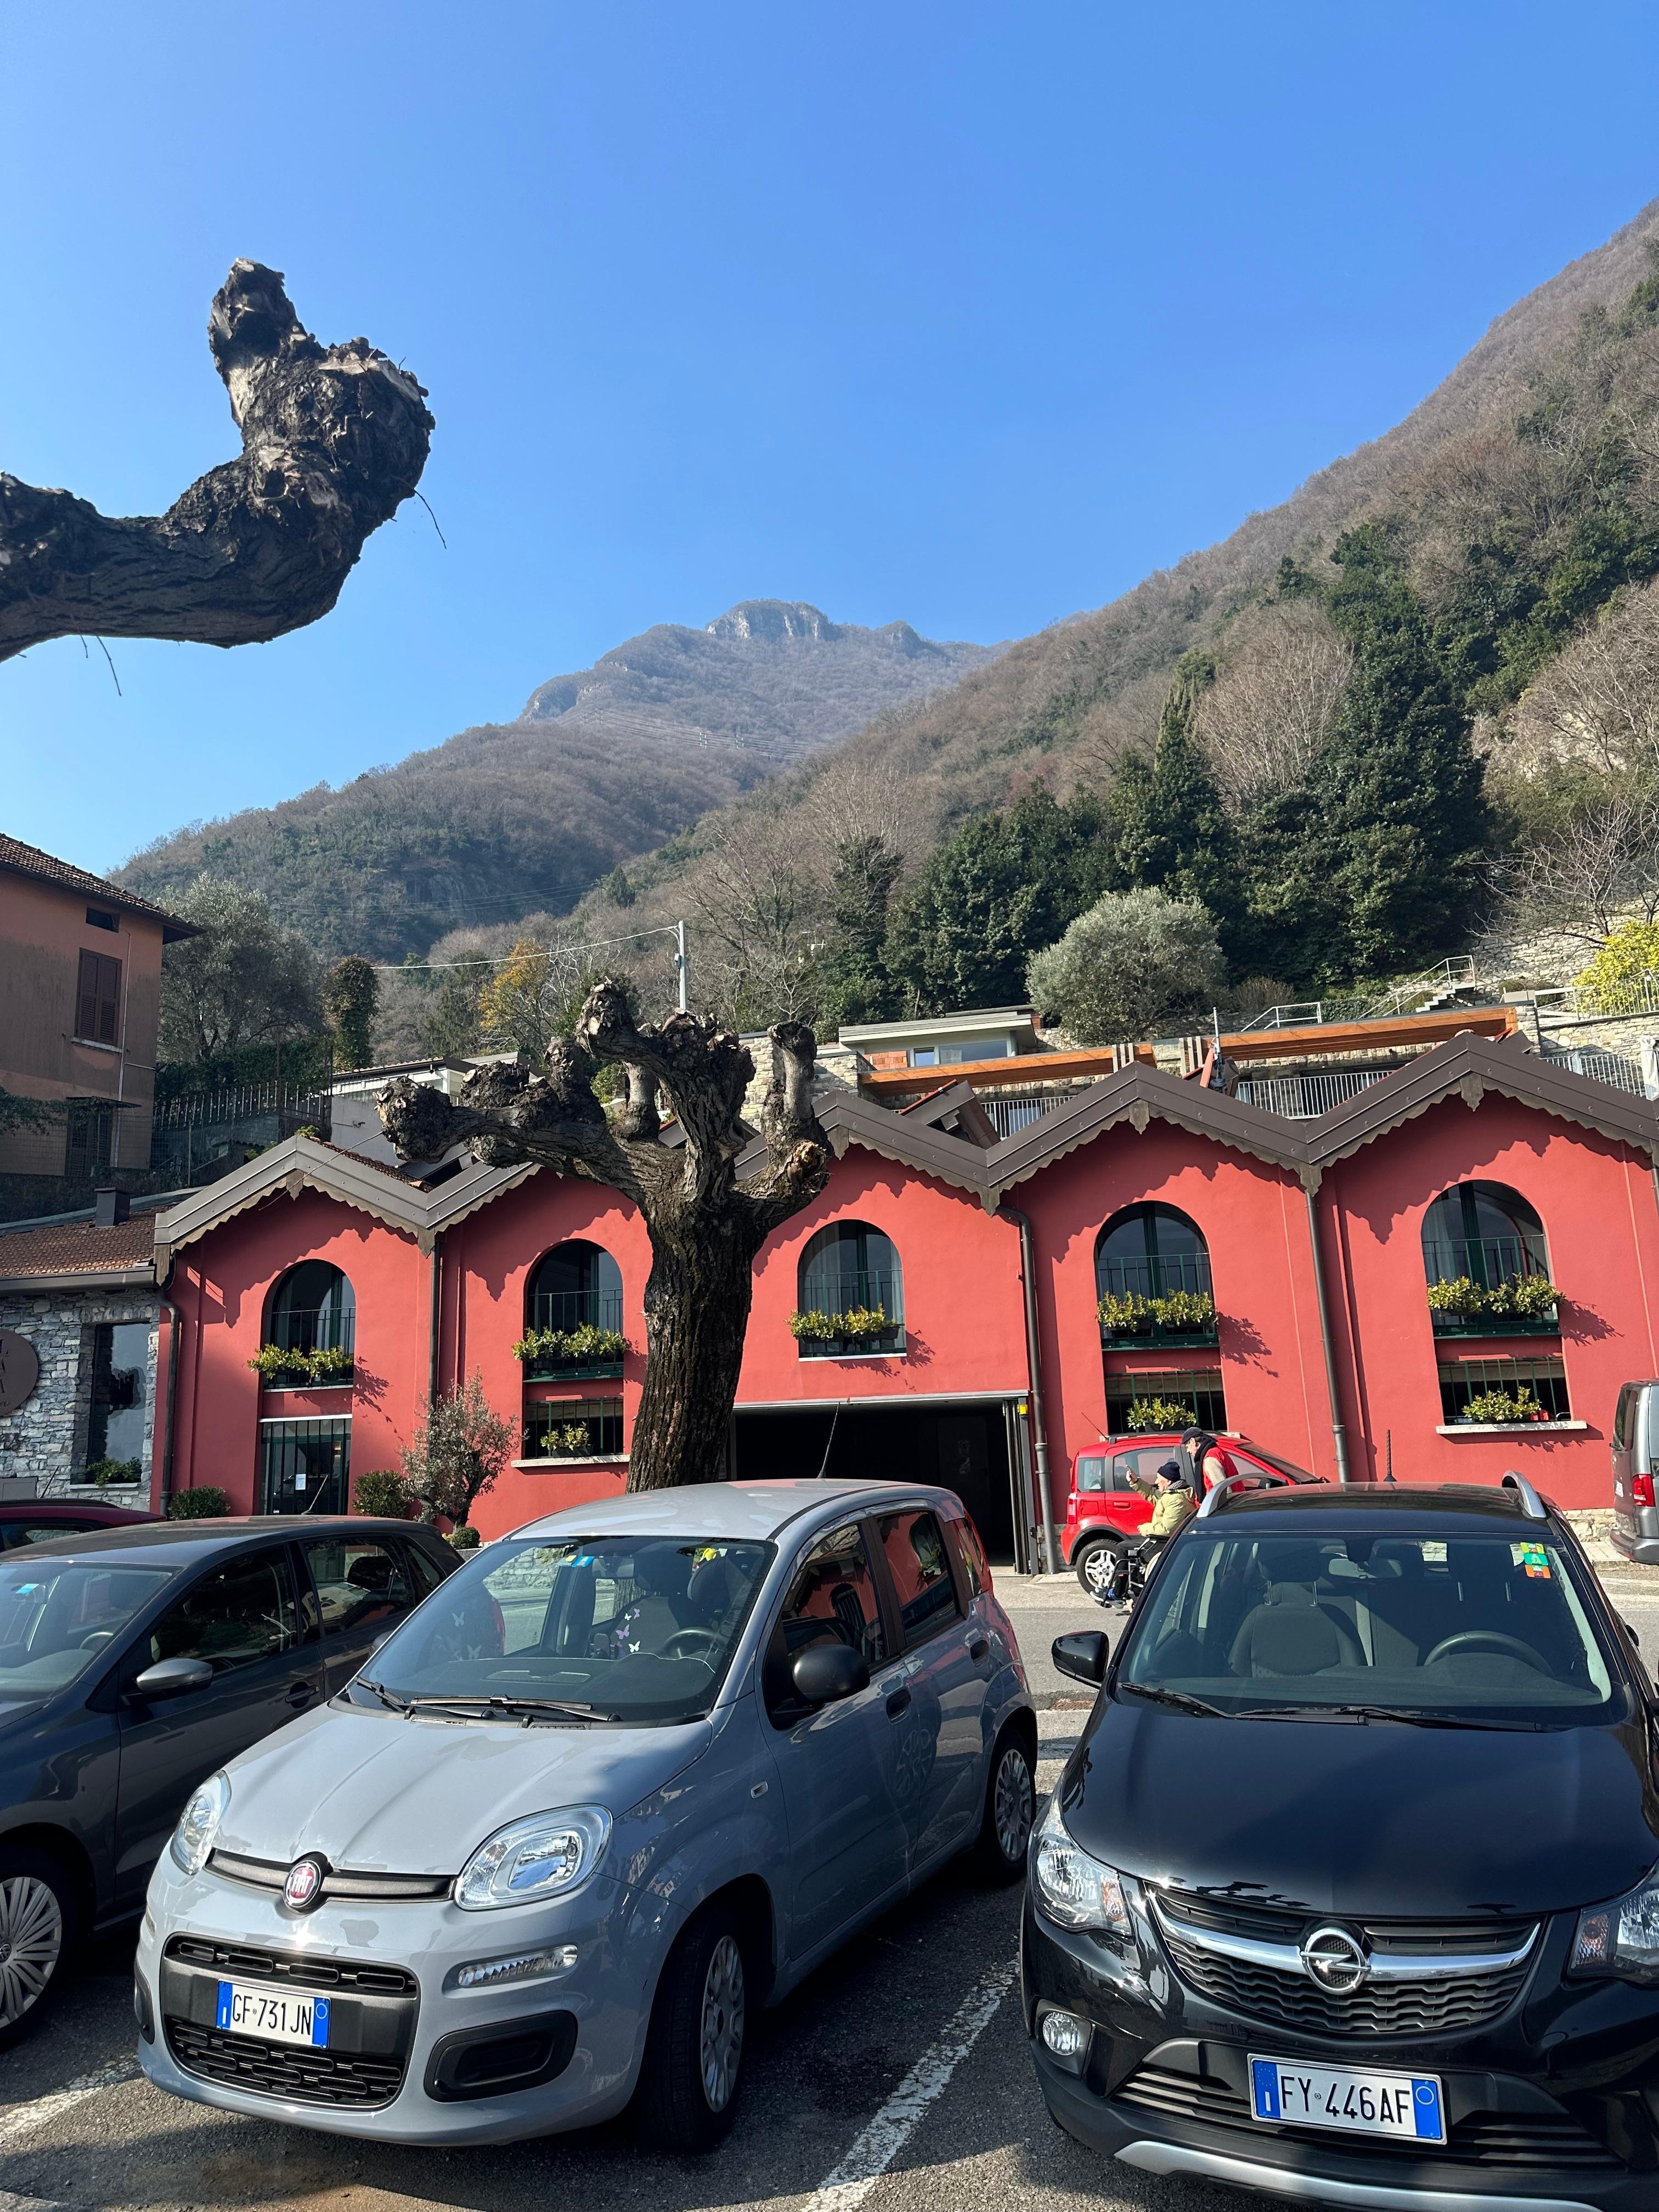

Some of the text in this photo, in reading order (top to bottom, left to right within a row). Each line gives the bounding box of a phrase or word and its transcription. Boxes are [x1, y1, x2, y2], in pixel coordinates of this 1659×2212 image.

[291, 1874, 313, 1894] FIAT
[233, 1994, 252, 2023] GF
[1280, 2076, 1410, 2124] FY 446AF
